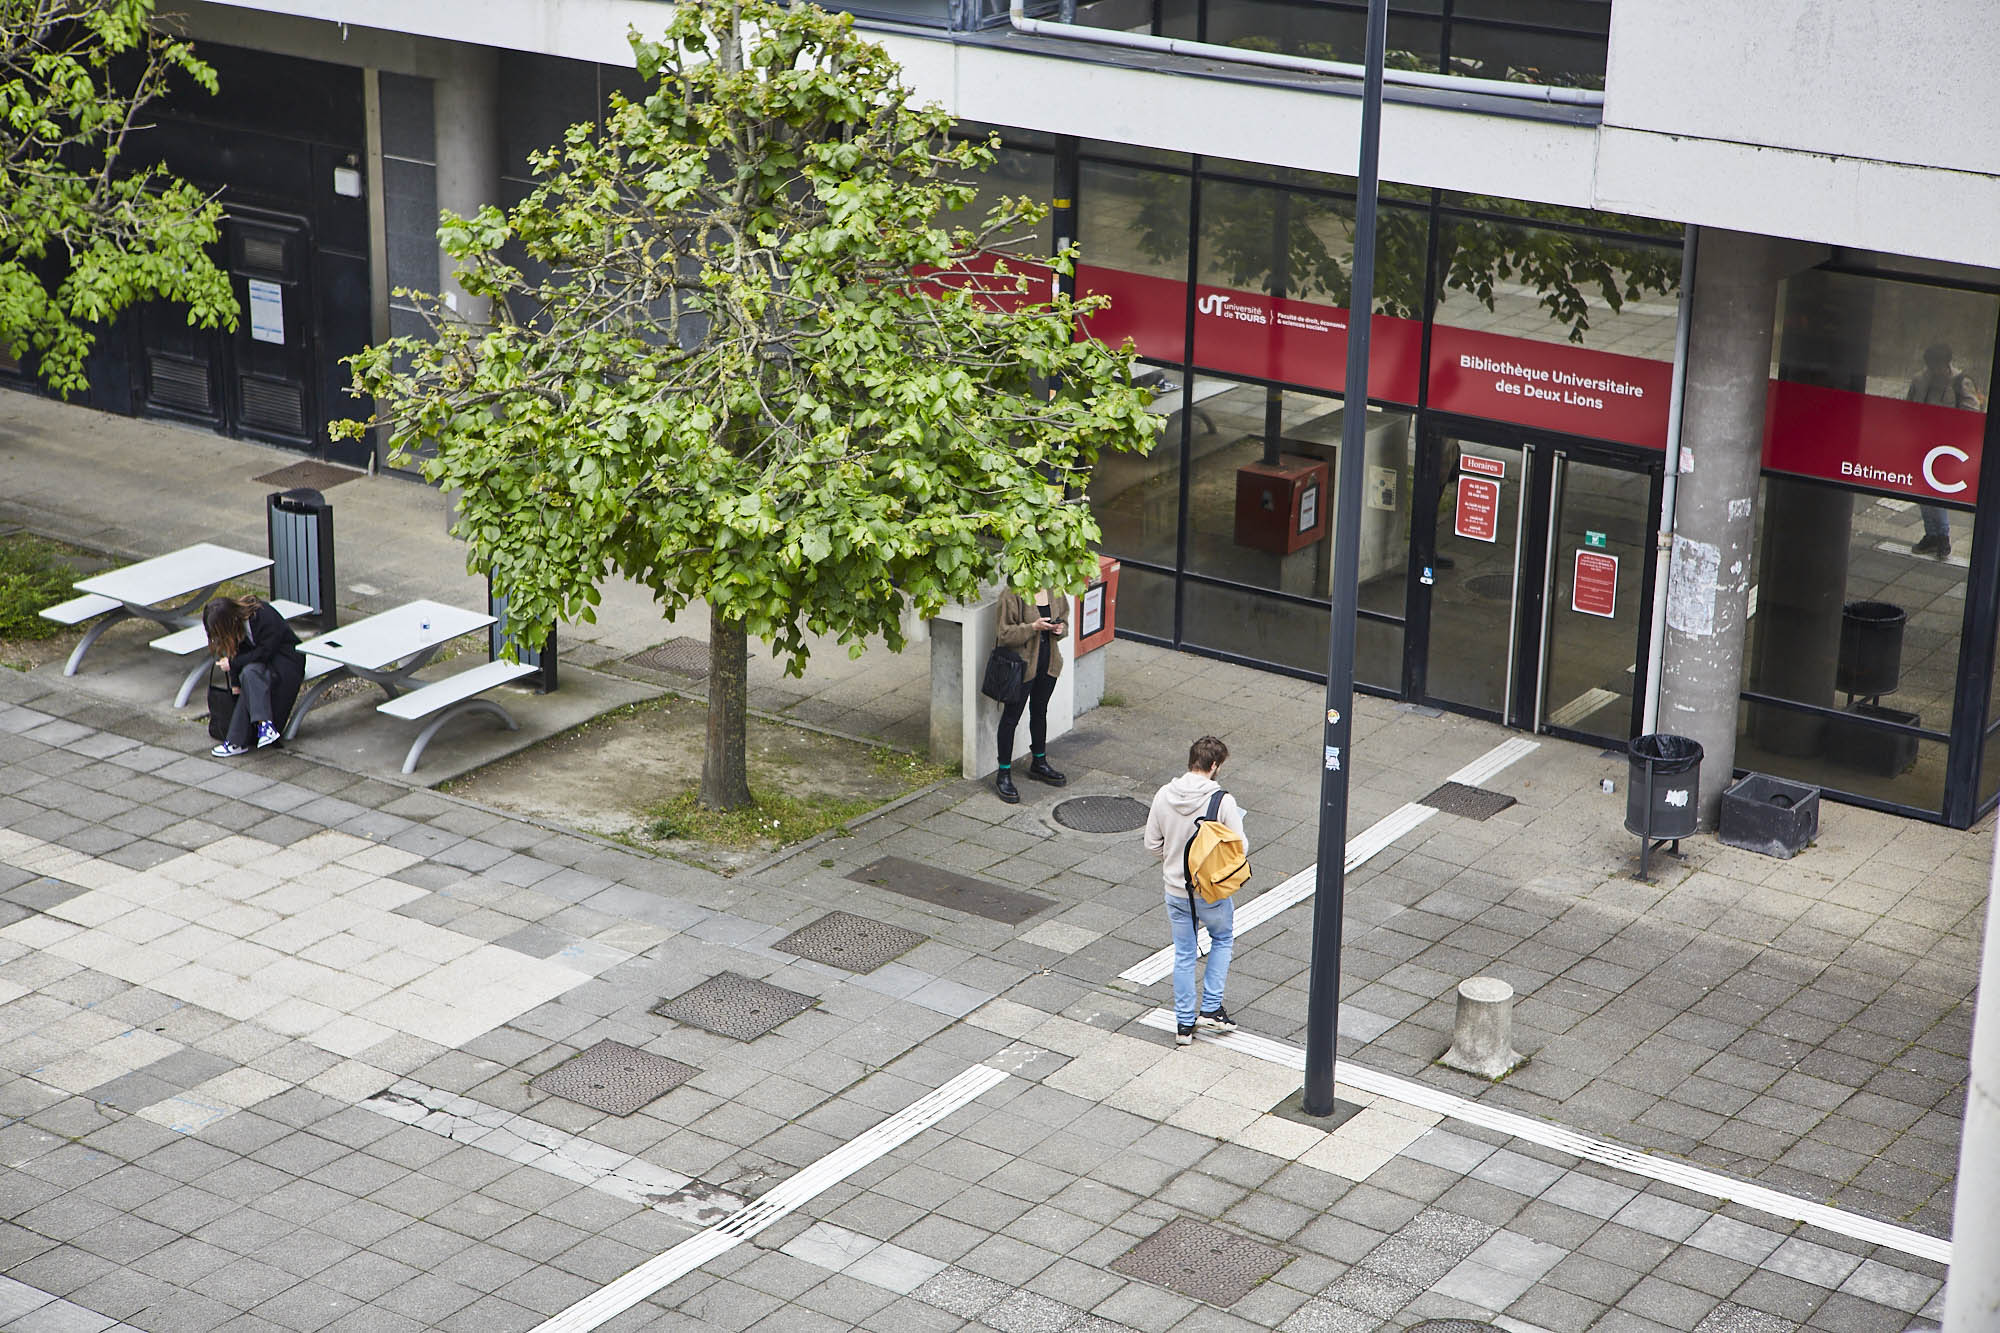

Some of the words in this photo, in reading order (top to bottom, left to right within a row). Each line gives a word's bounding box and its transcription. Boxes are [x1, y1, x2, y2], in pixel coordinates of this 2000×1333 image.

[1223, 303, 1262, 315] université
[1223, 311, 1234, 319] de
[1234, 311, 1267, 325] TOURS
[1277, 312, 1297, 321] Faculté
[1460, 354, 1549, 382] Bibliothèque
[1552, 370, 1644, 398] Universitaire
[1495, 379, 1521, 395] des
[1524, 383, 1561, 402] Deux
[1564, 390, 1604, 409] Lions
[1467, 458, 1498, 472] Horaires
[1841, 461, 1913, 486] Bâtiment
[1922, 445, 1969, 494] C
